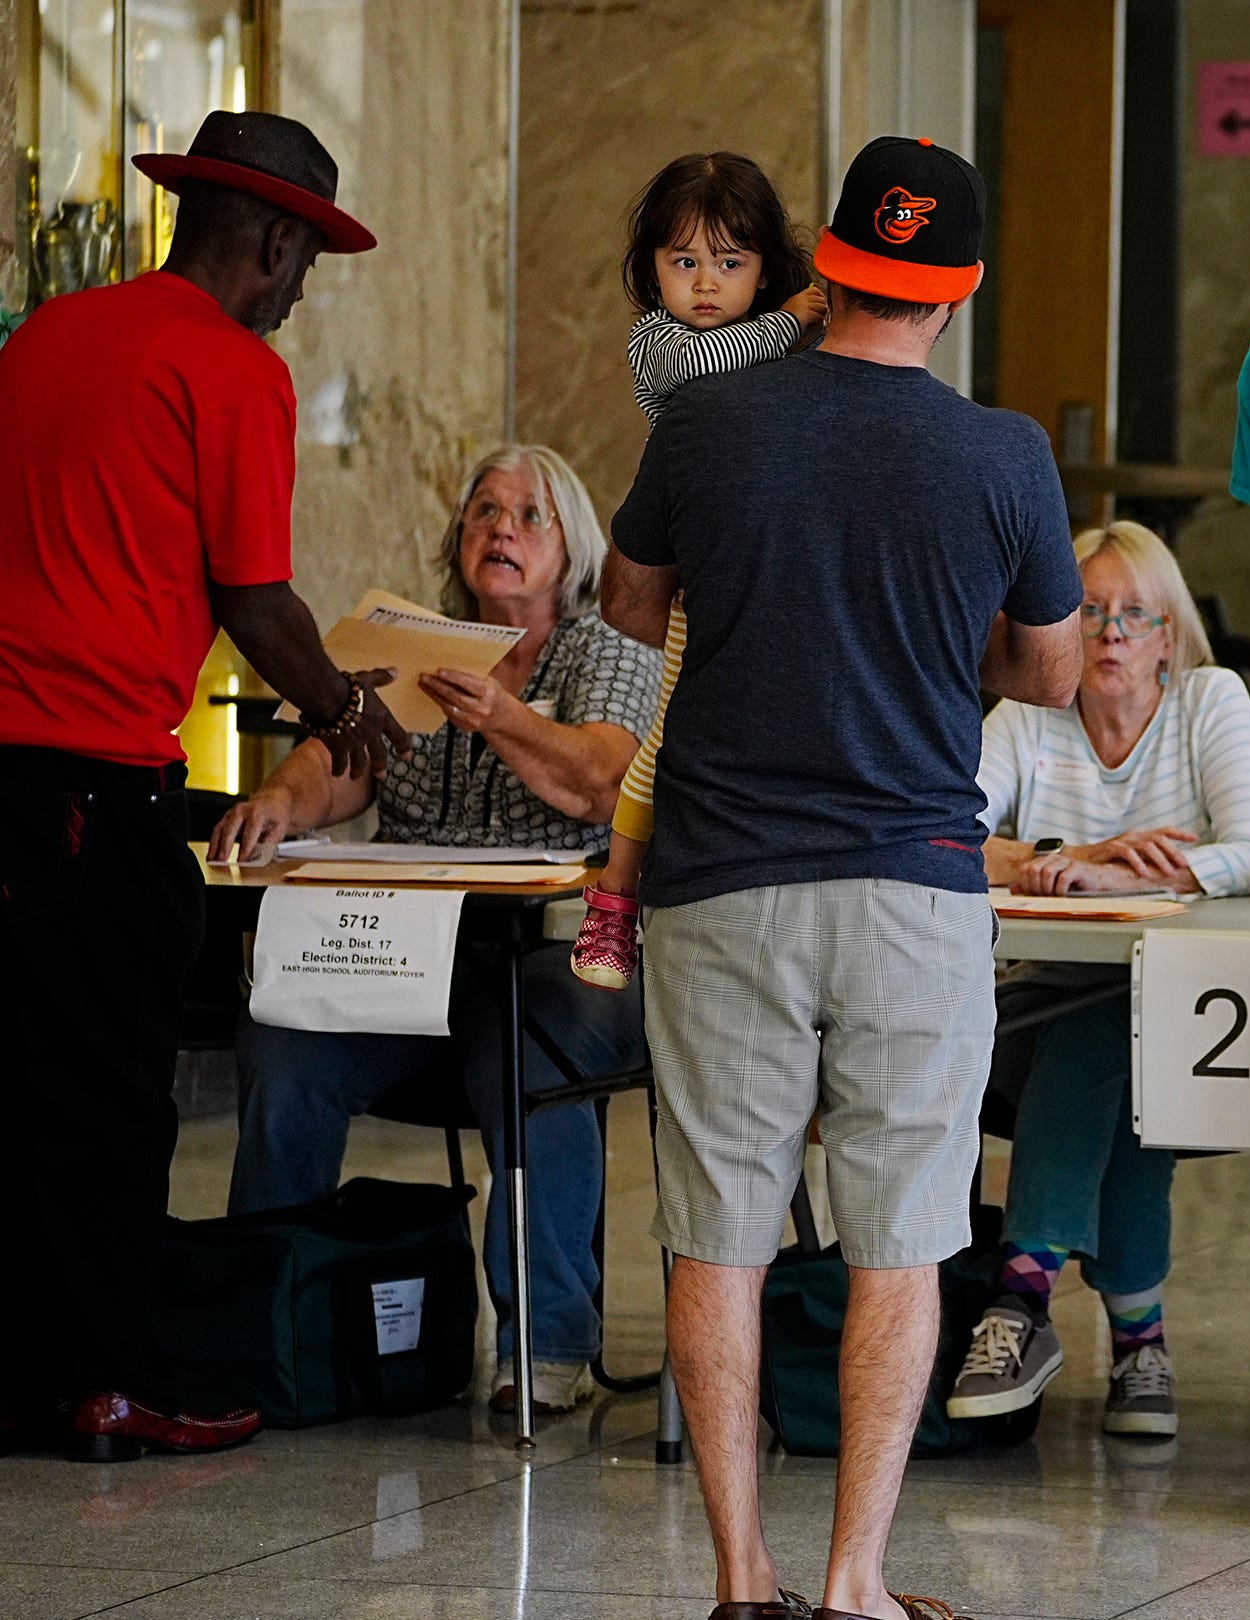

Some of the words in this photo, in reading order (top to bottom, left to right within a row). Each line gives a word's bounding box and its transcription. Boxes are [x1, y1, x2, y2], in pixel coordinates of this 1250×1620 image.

[336, 889, 370, 899] Ballot
[372, 890, 385, 899] ID
[338, 913, 380, 930] 5712
[320, 937, 345, 950] Leg.
[349, 937, 374, 950] Dist.
[379, 939, 392, 950] 17
[302, 951, 349, 965] Election
[351, 953, 397, 967] District:
[401, 958, 407, 966] 4
[282, 965, 301, 973] EAST
[302, 966, 321, 974] HIGH
[321, 967, 352, 976] SCHOOL
[353, 969, 398, 978] AUDITORIUM
[399, 971, 425, 979] FOYER
[1192, 988, 1250, 1079] 2
